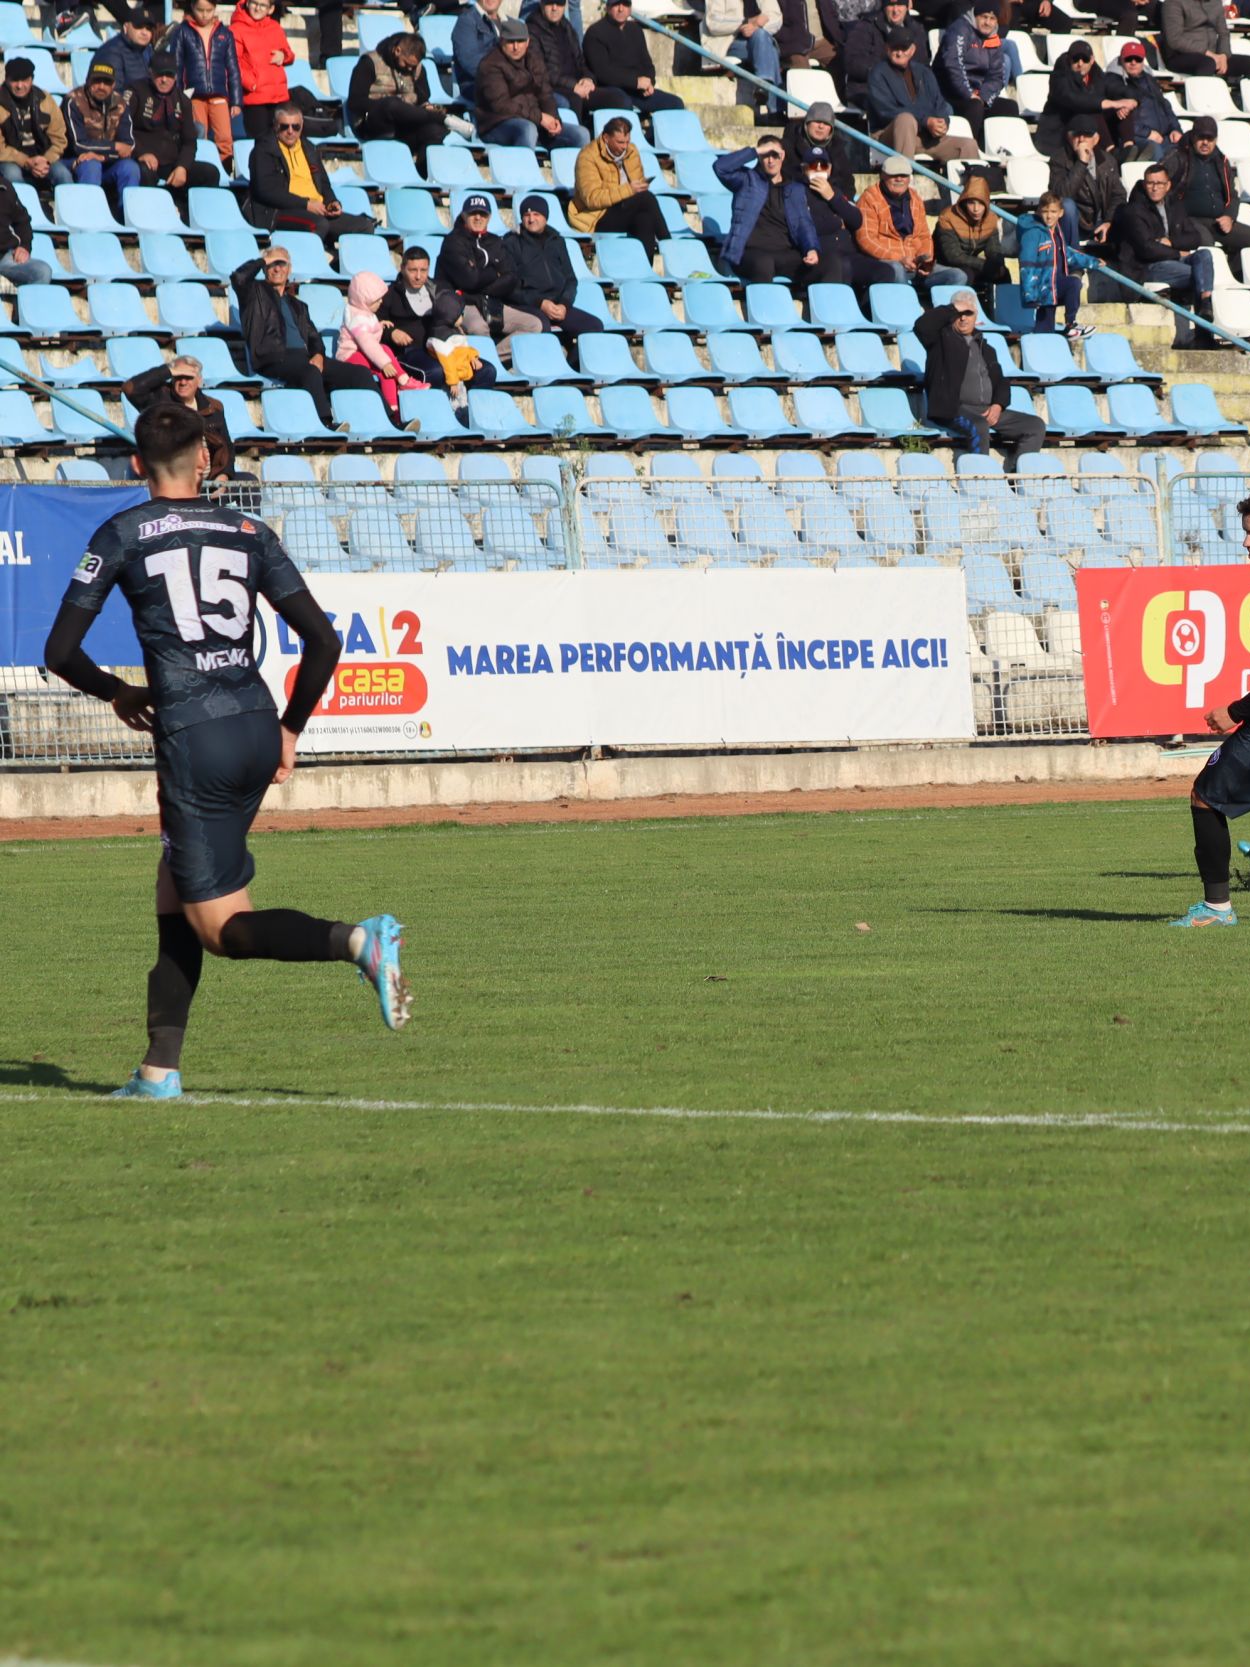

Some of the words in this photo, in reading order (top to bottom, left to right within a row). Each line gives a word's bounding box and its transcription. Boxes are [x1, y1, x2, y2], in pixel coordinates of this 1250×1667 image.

[144, 546, 250, 642] 15
[275, 611, 377, 655] LA
[391, 610, 424, 655] 2
[446, 643, 554, 676] MAREA
[559, 632, 772, 679] PERFORMANȚĂ
[776, 632, 875, 670] ÎNCEPE
[881, 638, 949, 669] AICI!
[338, 668, 405, 694] casa
[339, 692, 404, 710] pariurilor
